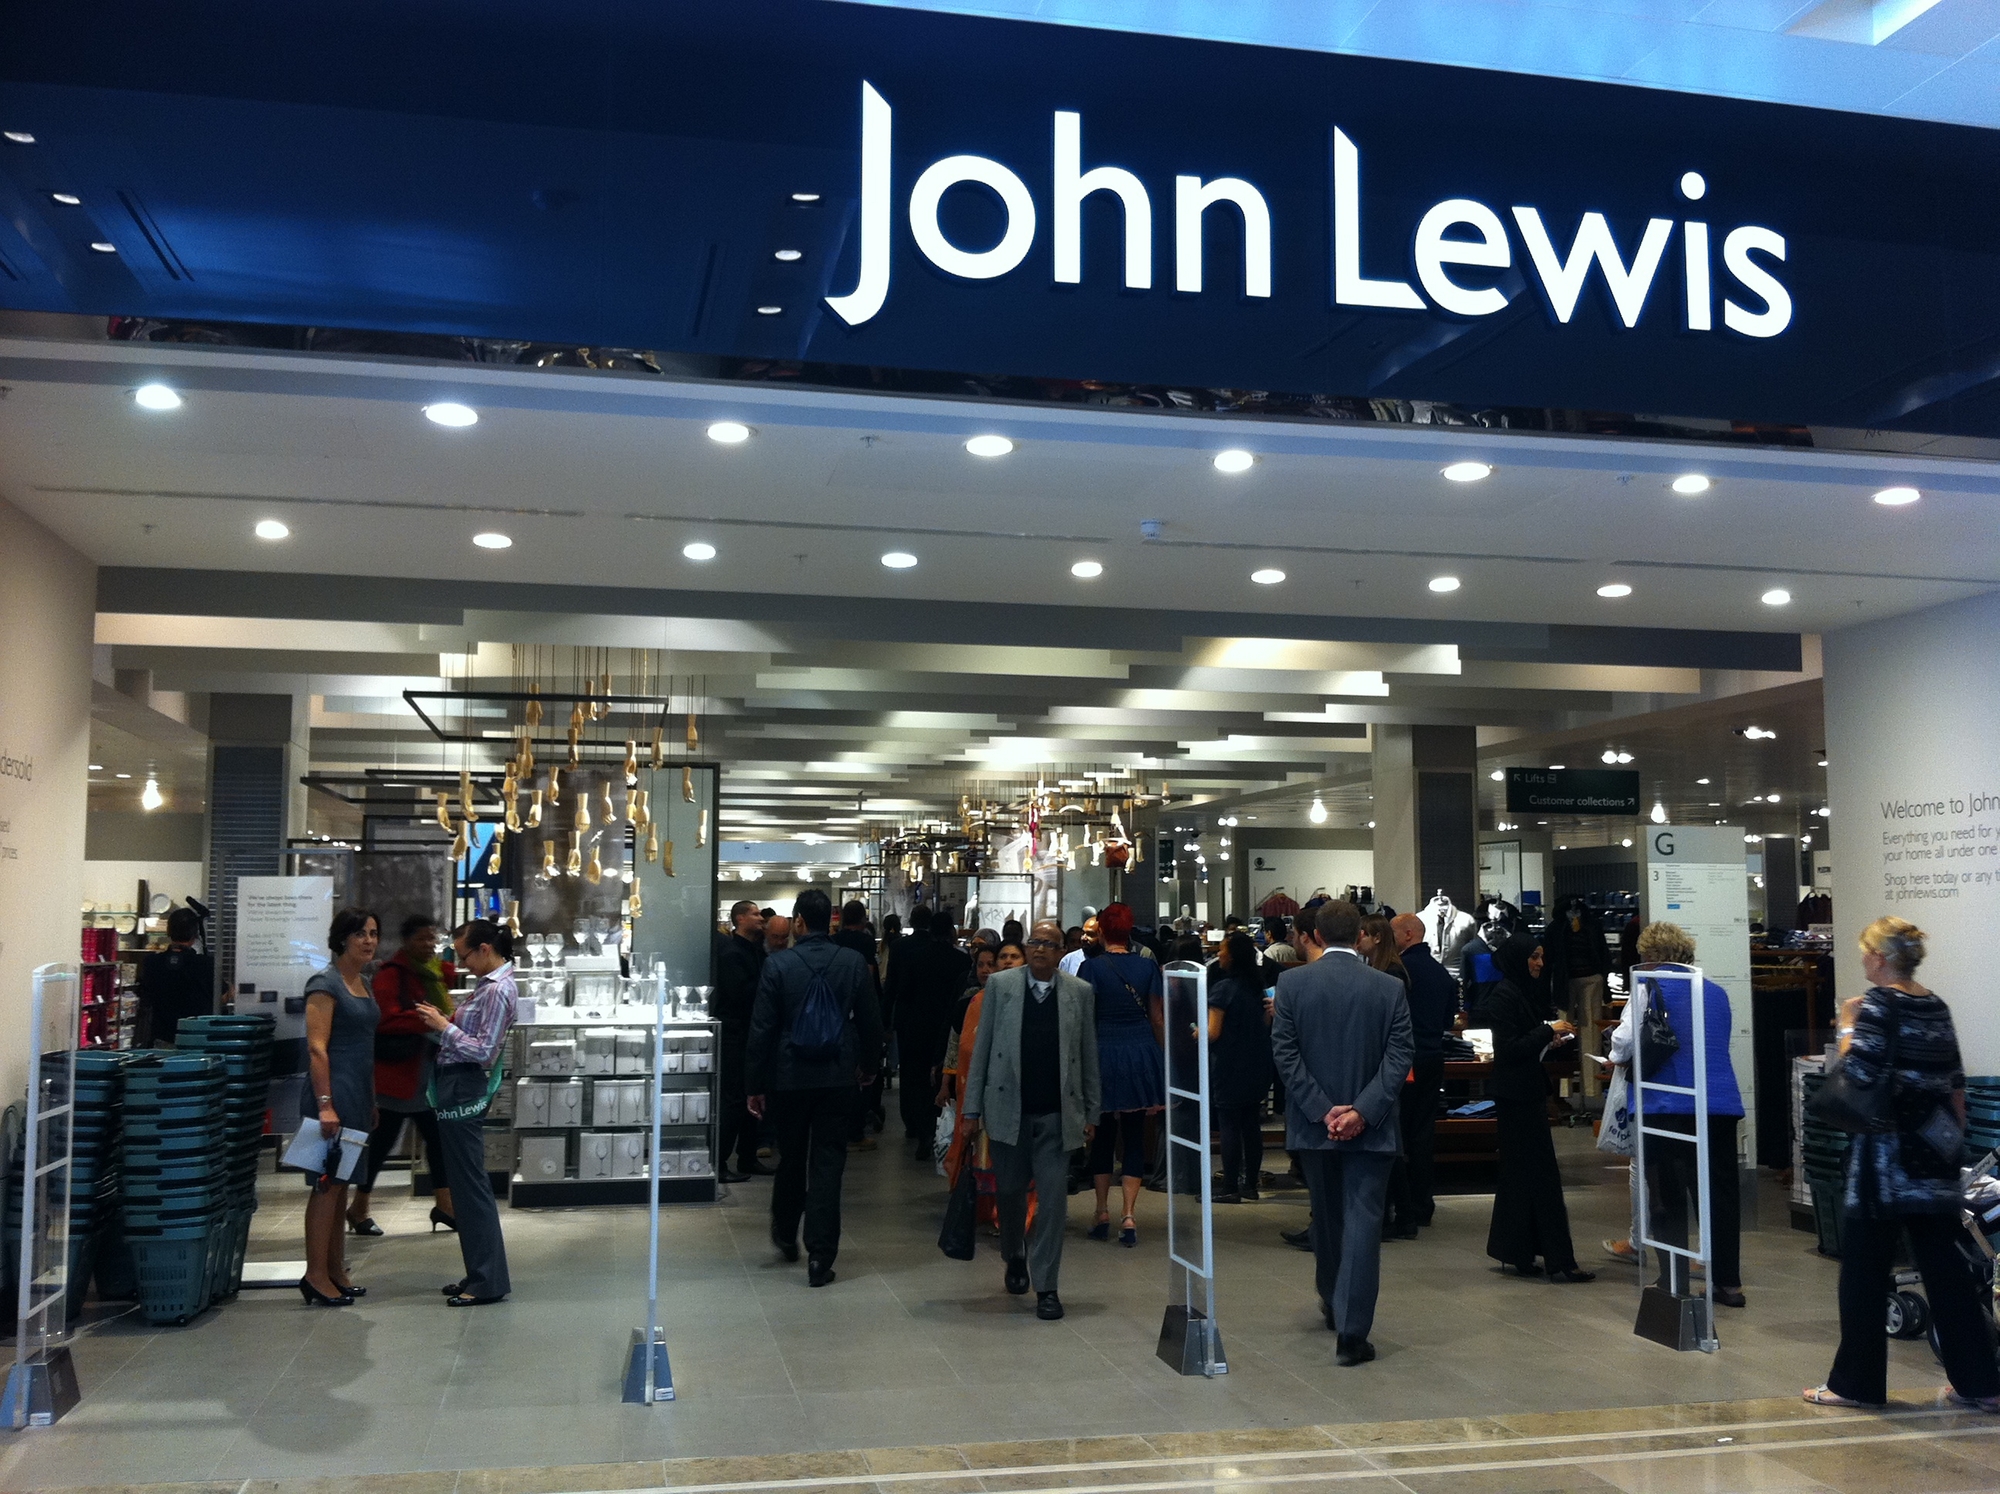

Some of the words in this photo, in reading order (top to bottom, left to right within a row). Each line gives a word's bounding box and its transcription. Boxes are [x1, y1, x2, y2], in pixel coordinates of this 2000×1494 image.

[824, 79, 1271, 326] John
[1334, 124, 1792, 338] Lewis
[1525, 773, 1545, 784] Lifts
[1528, 794, 1574, 806] Customer
[1576, 796, 1625, 806] collections
[1880, 800, 1945, 819] Welcome
[1949, 798, 1964, 814] to
[1968, 792, 2000, 818] John
[1655, 832, 1674, 856] G
[1882, 830, 1928, 847] Everything
[1930, 831, 1948, 845] you
[1951, 825, 1974, 840] need
[1978, 824, 1992, 838] for
[1883, 850, 1902, 865] your
[1906, 848, 1932, 860] home
[1934, 846, 1944, 858] all
[1948, 844, 1974, 858] under
[1978, 845, 1998, 856] one
[1653, 870, 1660, 882] 3
[1884, 872, 1907, 888] Shop
[1909, 872, 1930, 884] here
[1932, 870, 1958, 886] today
[1961, 872, 1972, 883] or
[1975, 871, 1992, 885] any
[1884, 890, 1894, 900] at
[1896, 886, 1958, 903] johnlewis.com
[435, 1109, 458, 1122] John
[460, 1100, 488, 1117] Lewis
